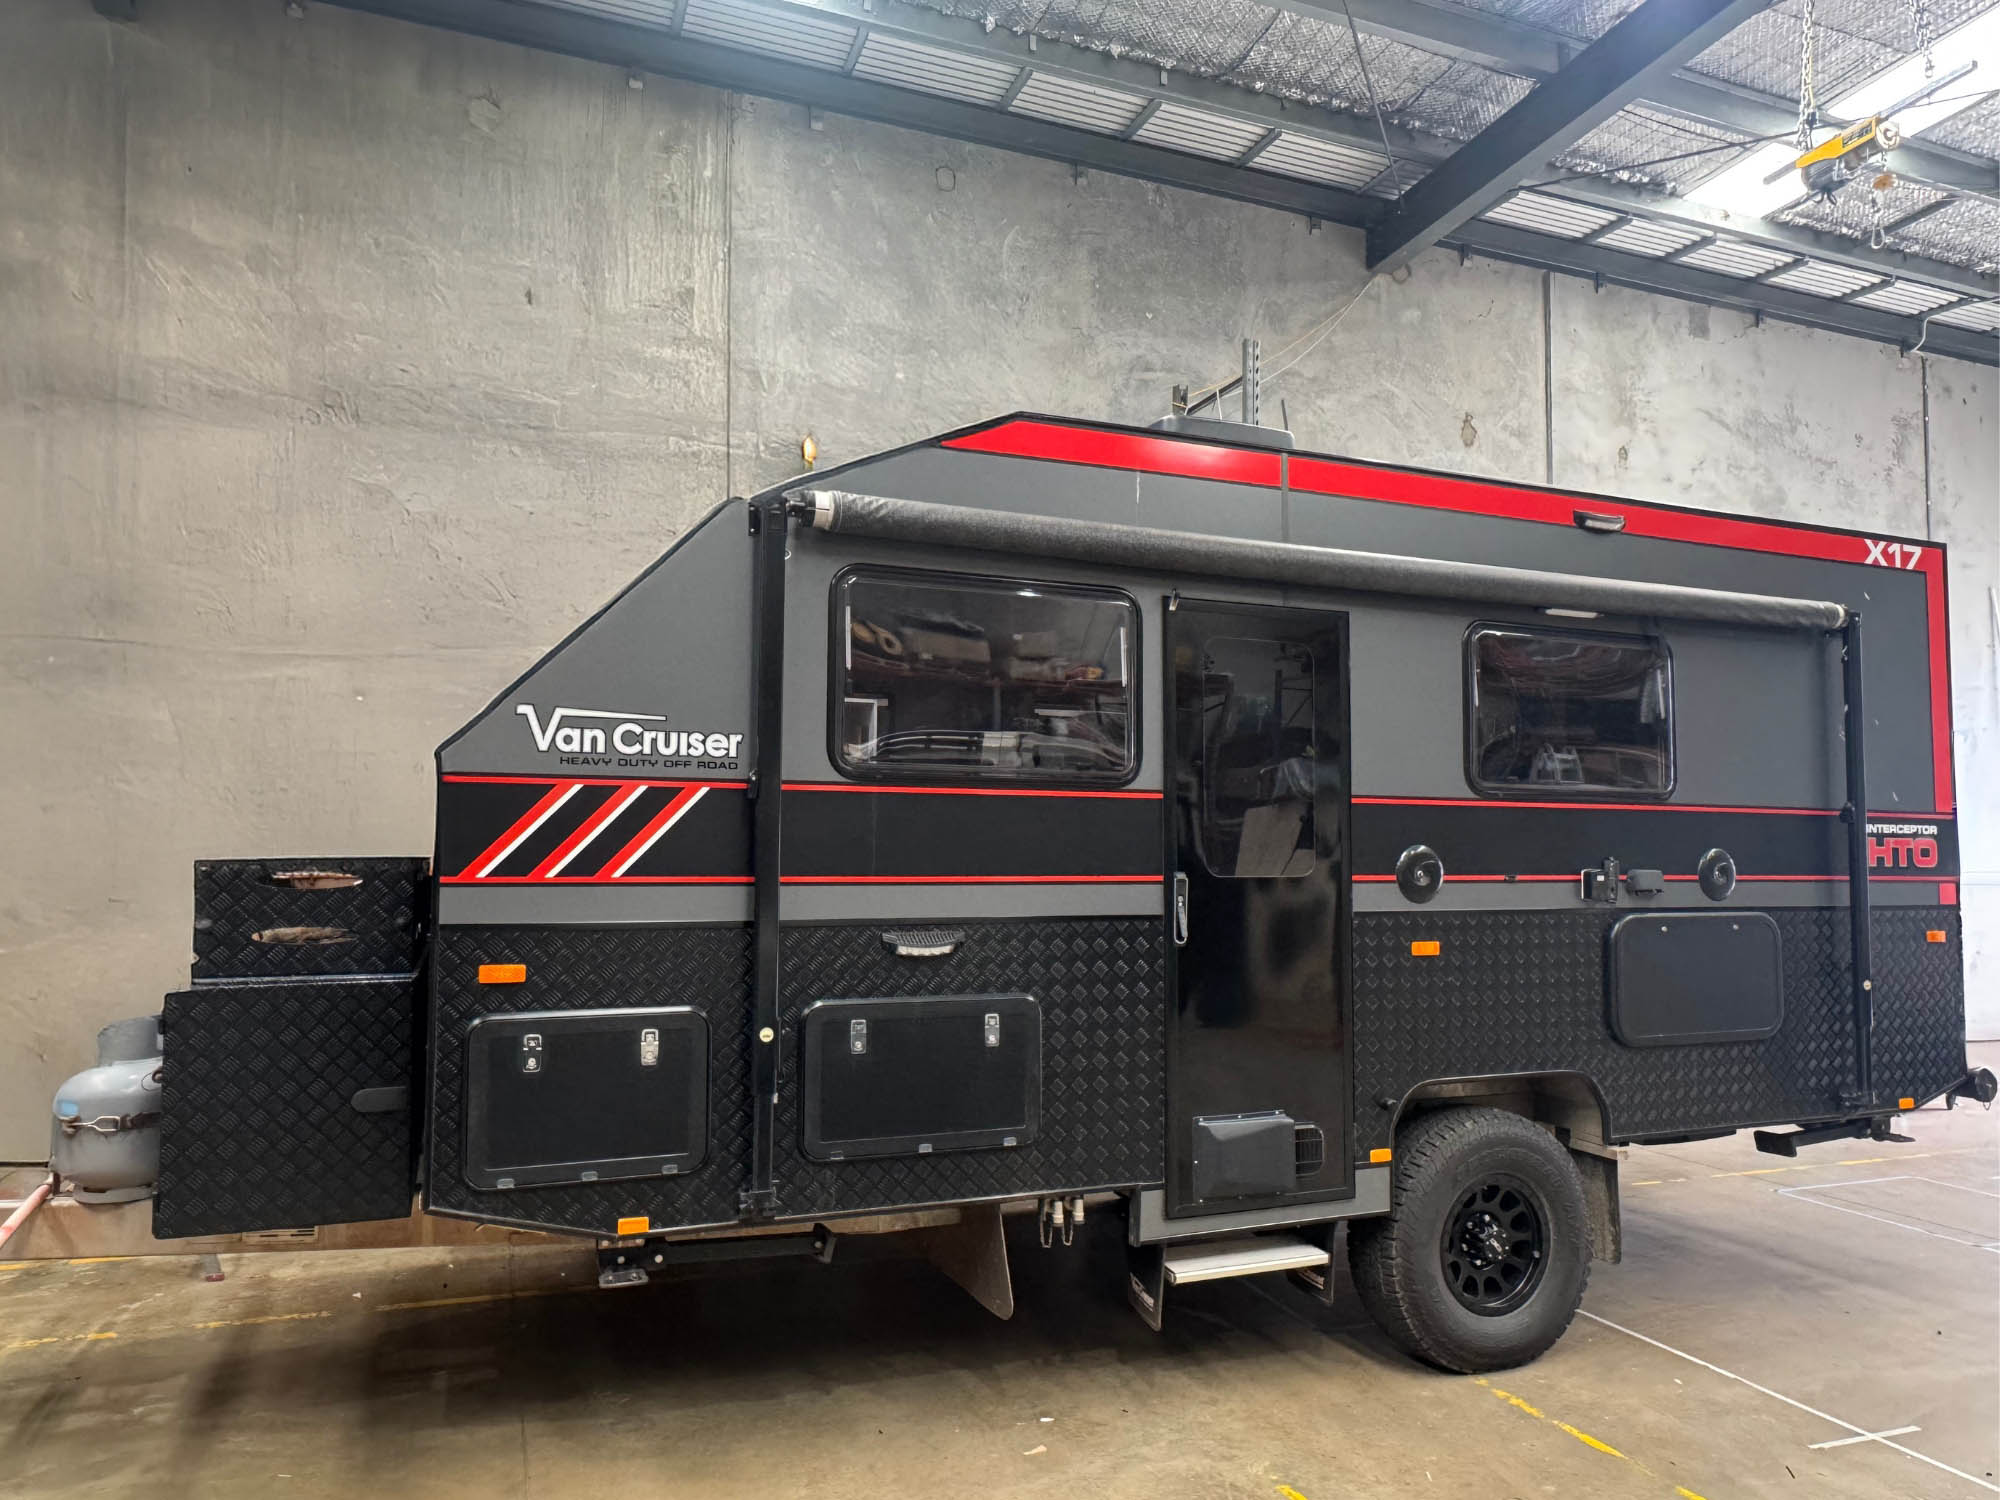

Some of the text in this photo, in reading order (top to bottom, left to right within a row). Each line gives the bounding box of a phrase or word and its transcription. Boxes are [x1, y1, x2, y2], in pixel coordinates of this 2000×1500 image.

[1863, 538, 1922, 570] X17
[515, 703, 744, 758] Van Cruiser
[559, 756, 739, 770] HEAVY DUTY OFF ROAD
[1866, 824, 1938, 835] INTERCEPTOR
[1868, 837, 1938, 868] HTO
